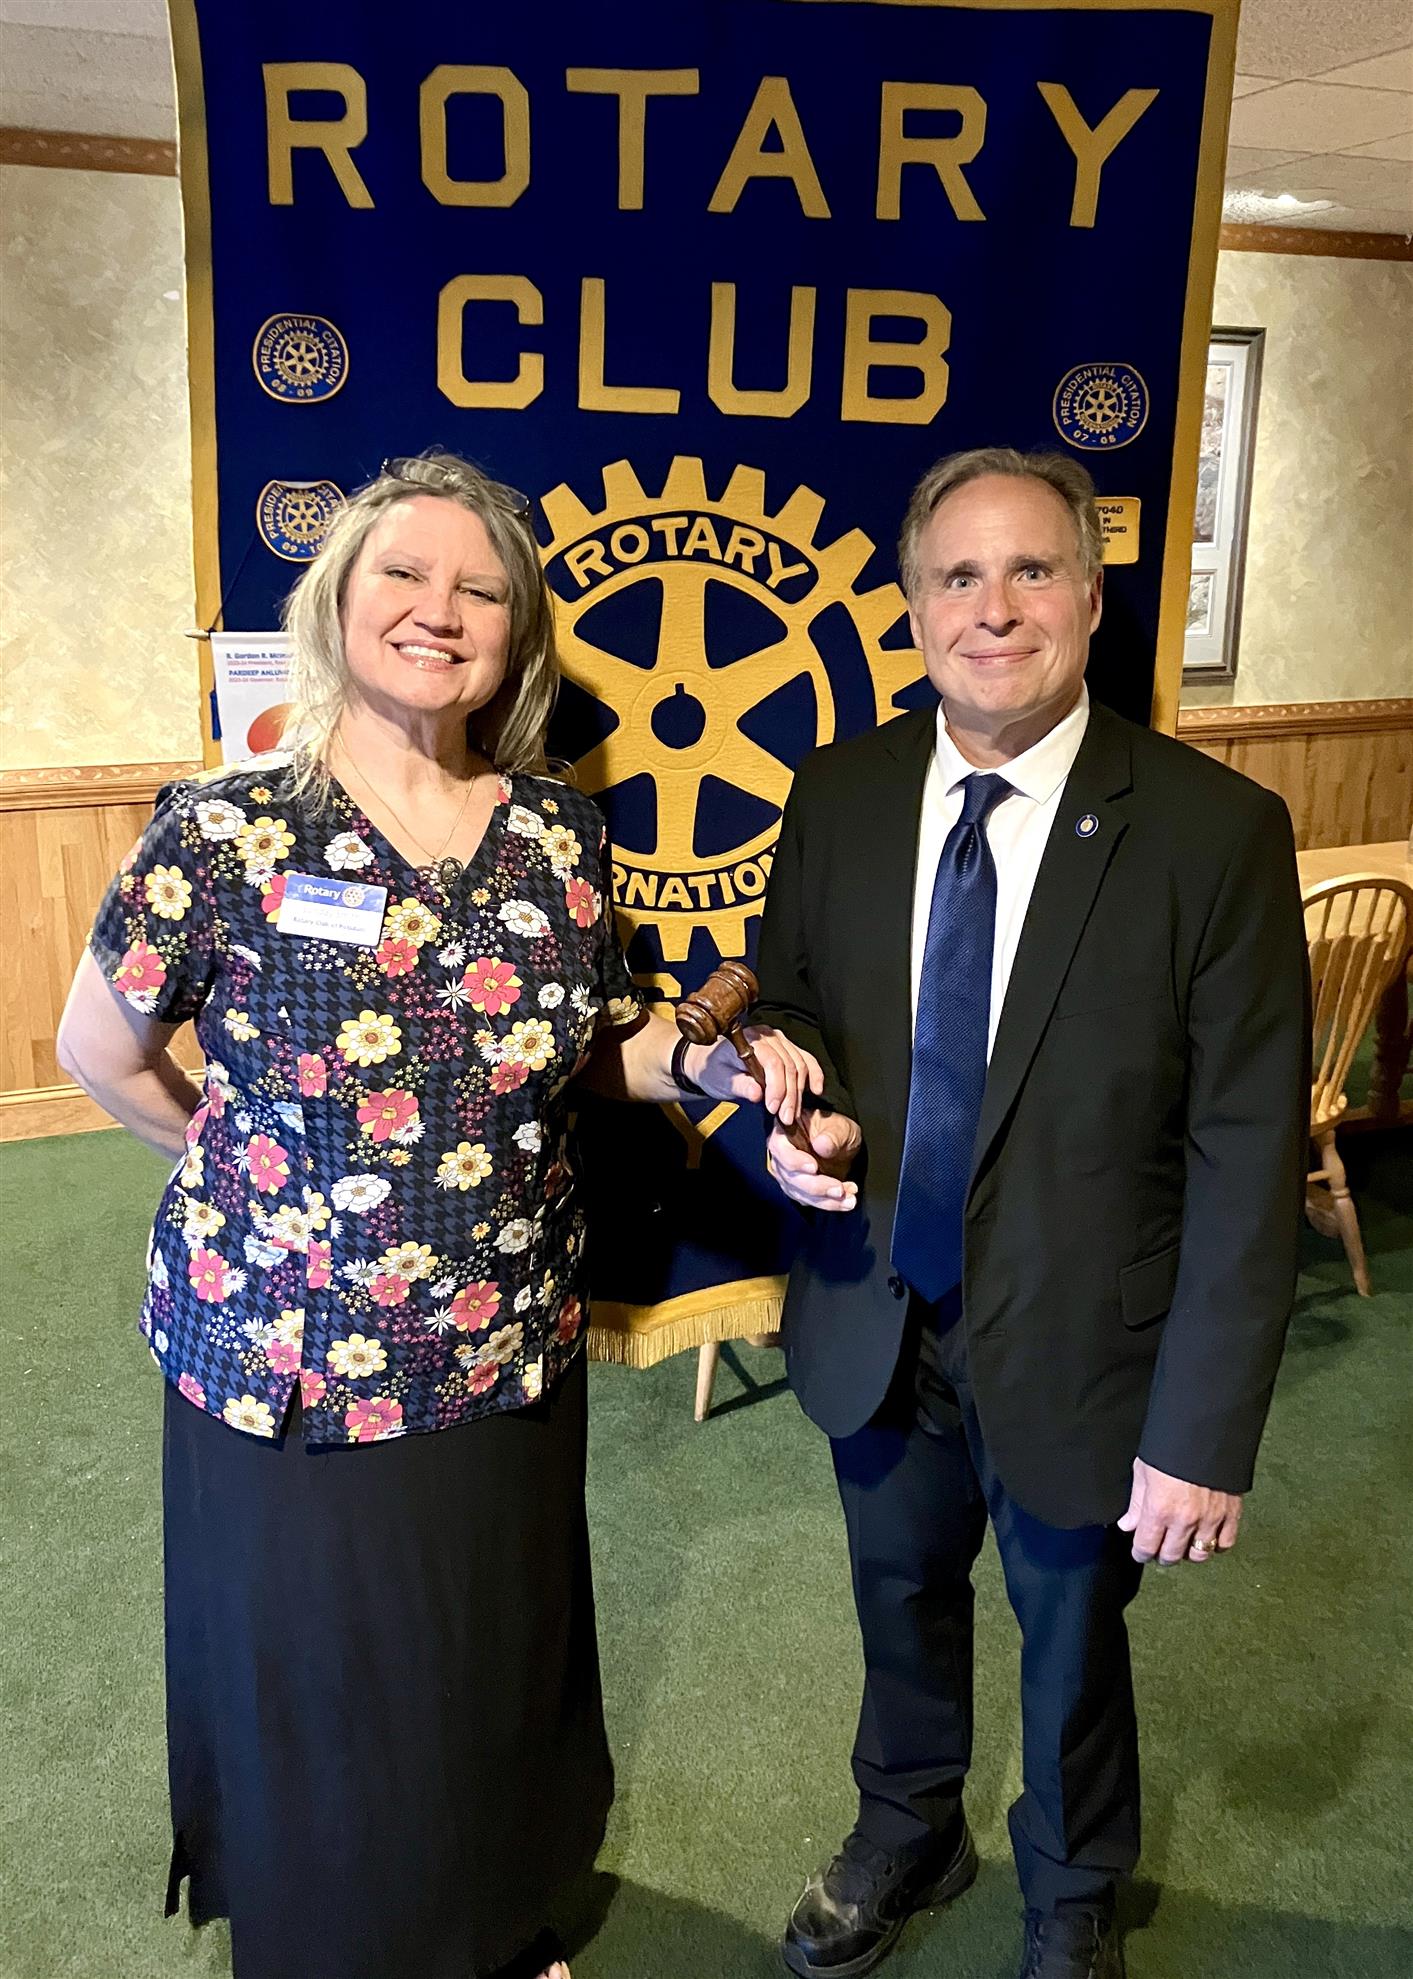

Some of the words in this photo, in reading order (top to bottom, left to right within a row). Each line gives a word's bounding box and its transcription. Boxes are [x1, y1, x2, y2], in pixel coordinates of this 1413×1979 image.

[263, 62, 1160, 228] ROTARY
[260, 318, 318, 373] PRESIDENTIAL
[322, 330, 342, 385] CITATION
[436, 274, 952, 424] CLUB
[1060, 366, 1117, 426] PRESIDENTIAL
[1121, 374, 1141, 428] CITATION
[563, 515, 809, 589] ROTARY
[303, 883, 341, 900] Rotary
